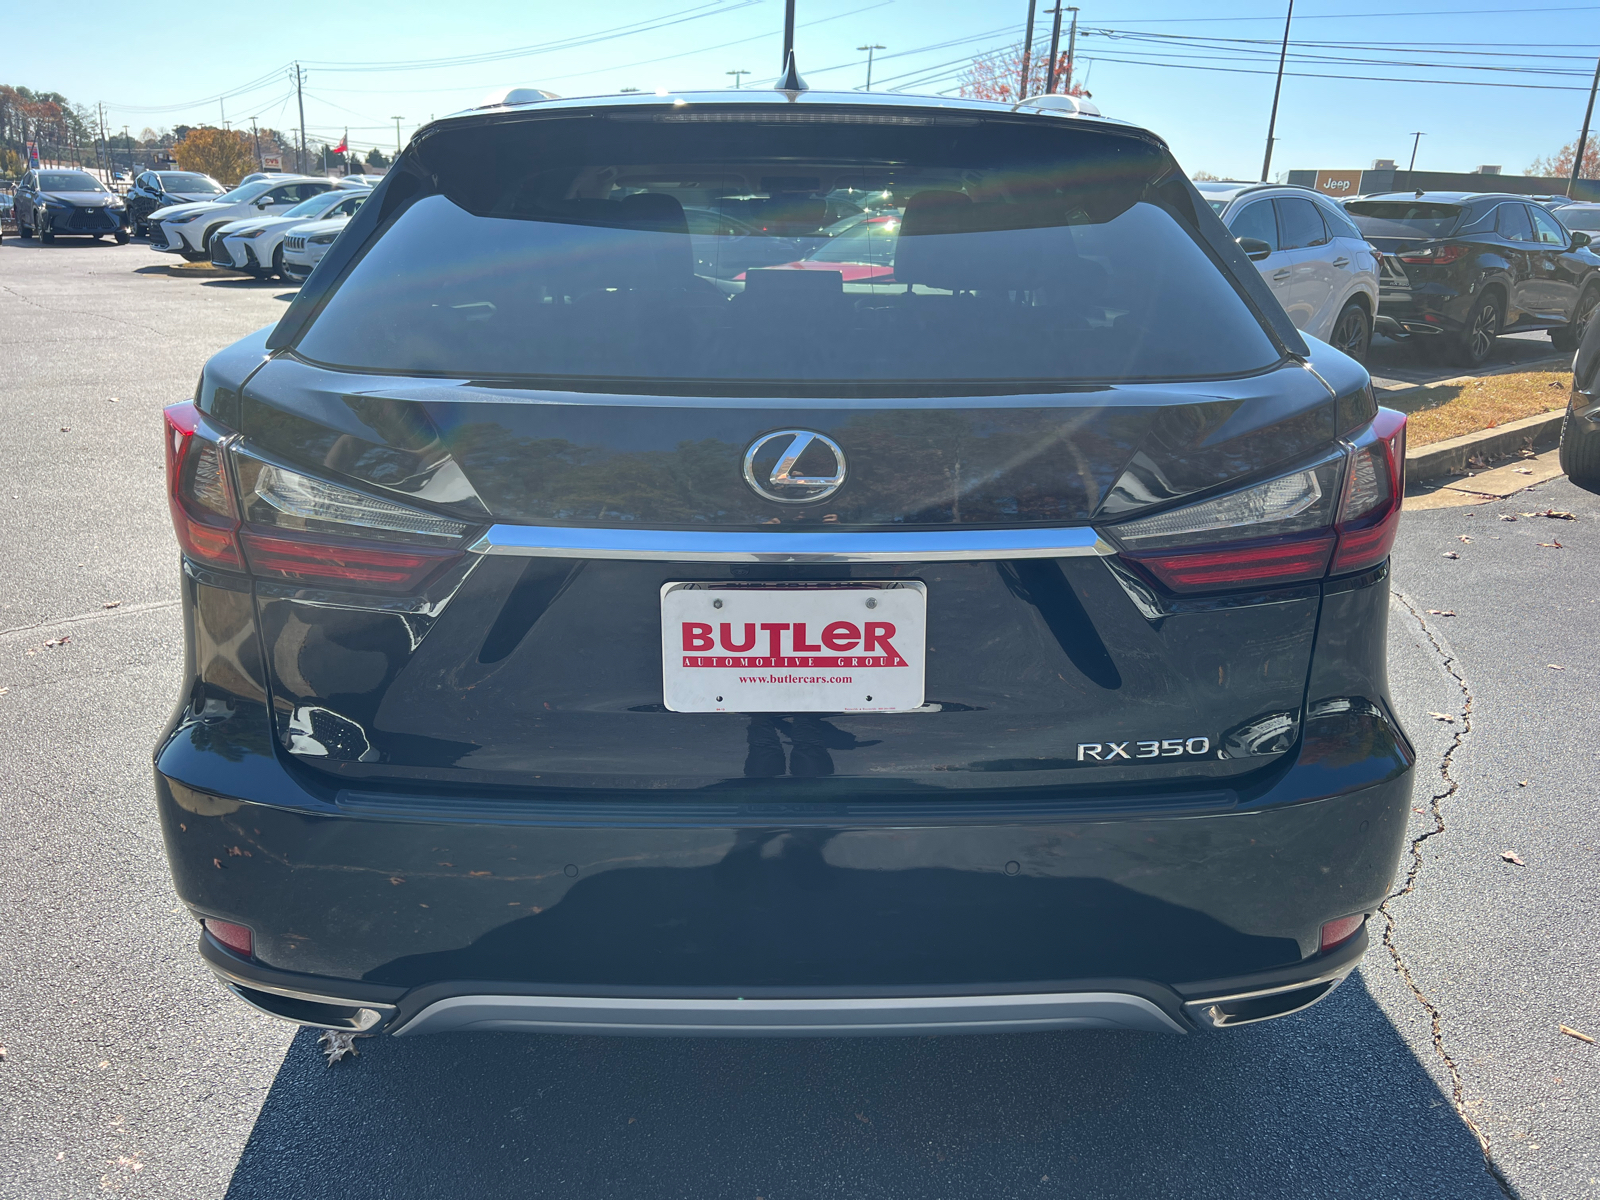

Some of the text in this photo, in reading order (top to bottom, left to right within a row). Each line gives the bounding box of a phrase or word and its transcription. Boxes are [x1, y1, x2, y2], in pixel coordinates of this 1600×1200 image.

[1323, 177, 1350, 191] Jeep
[684, 657, 900, 667] AUTOMOTIVE GROUP
[739, 674, 853, 685] www.butlercars.com
[1077, 736, 1210, 761] RX 350
